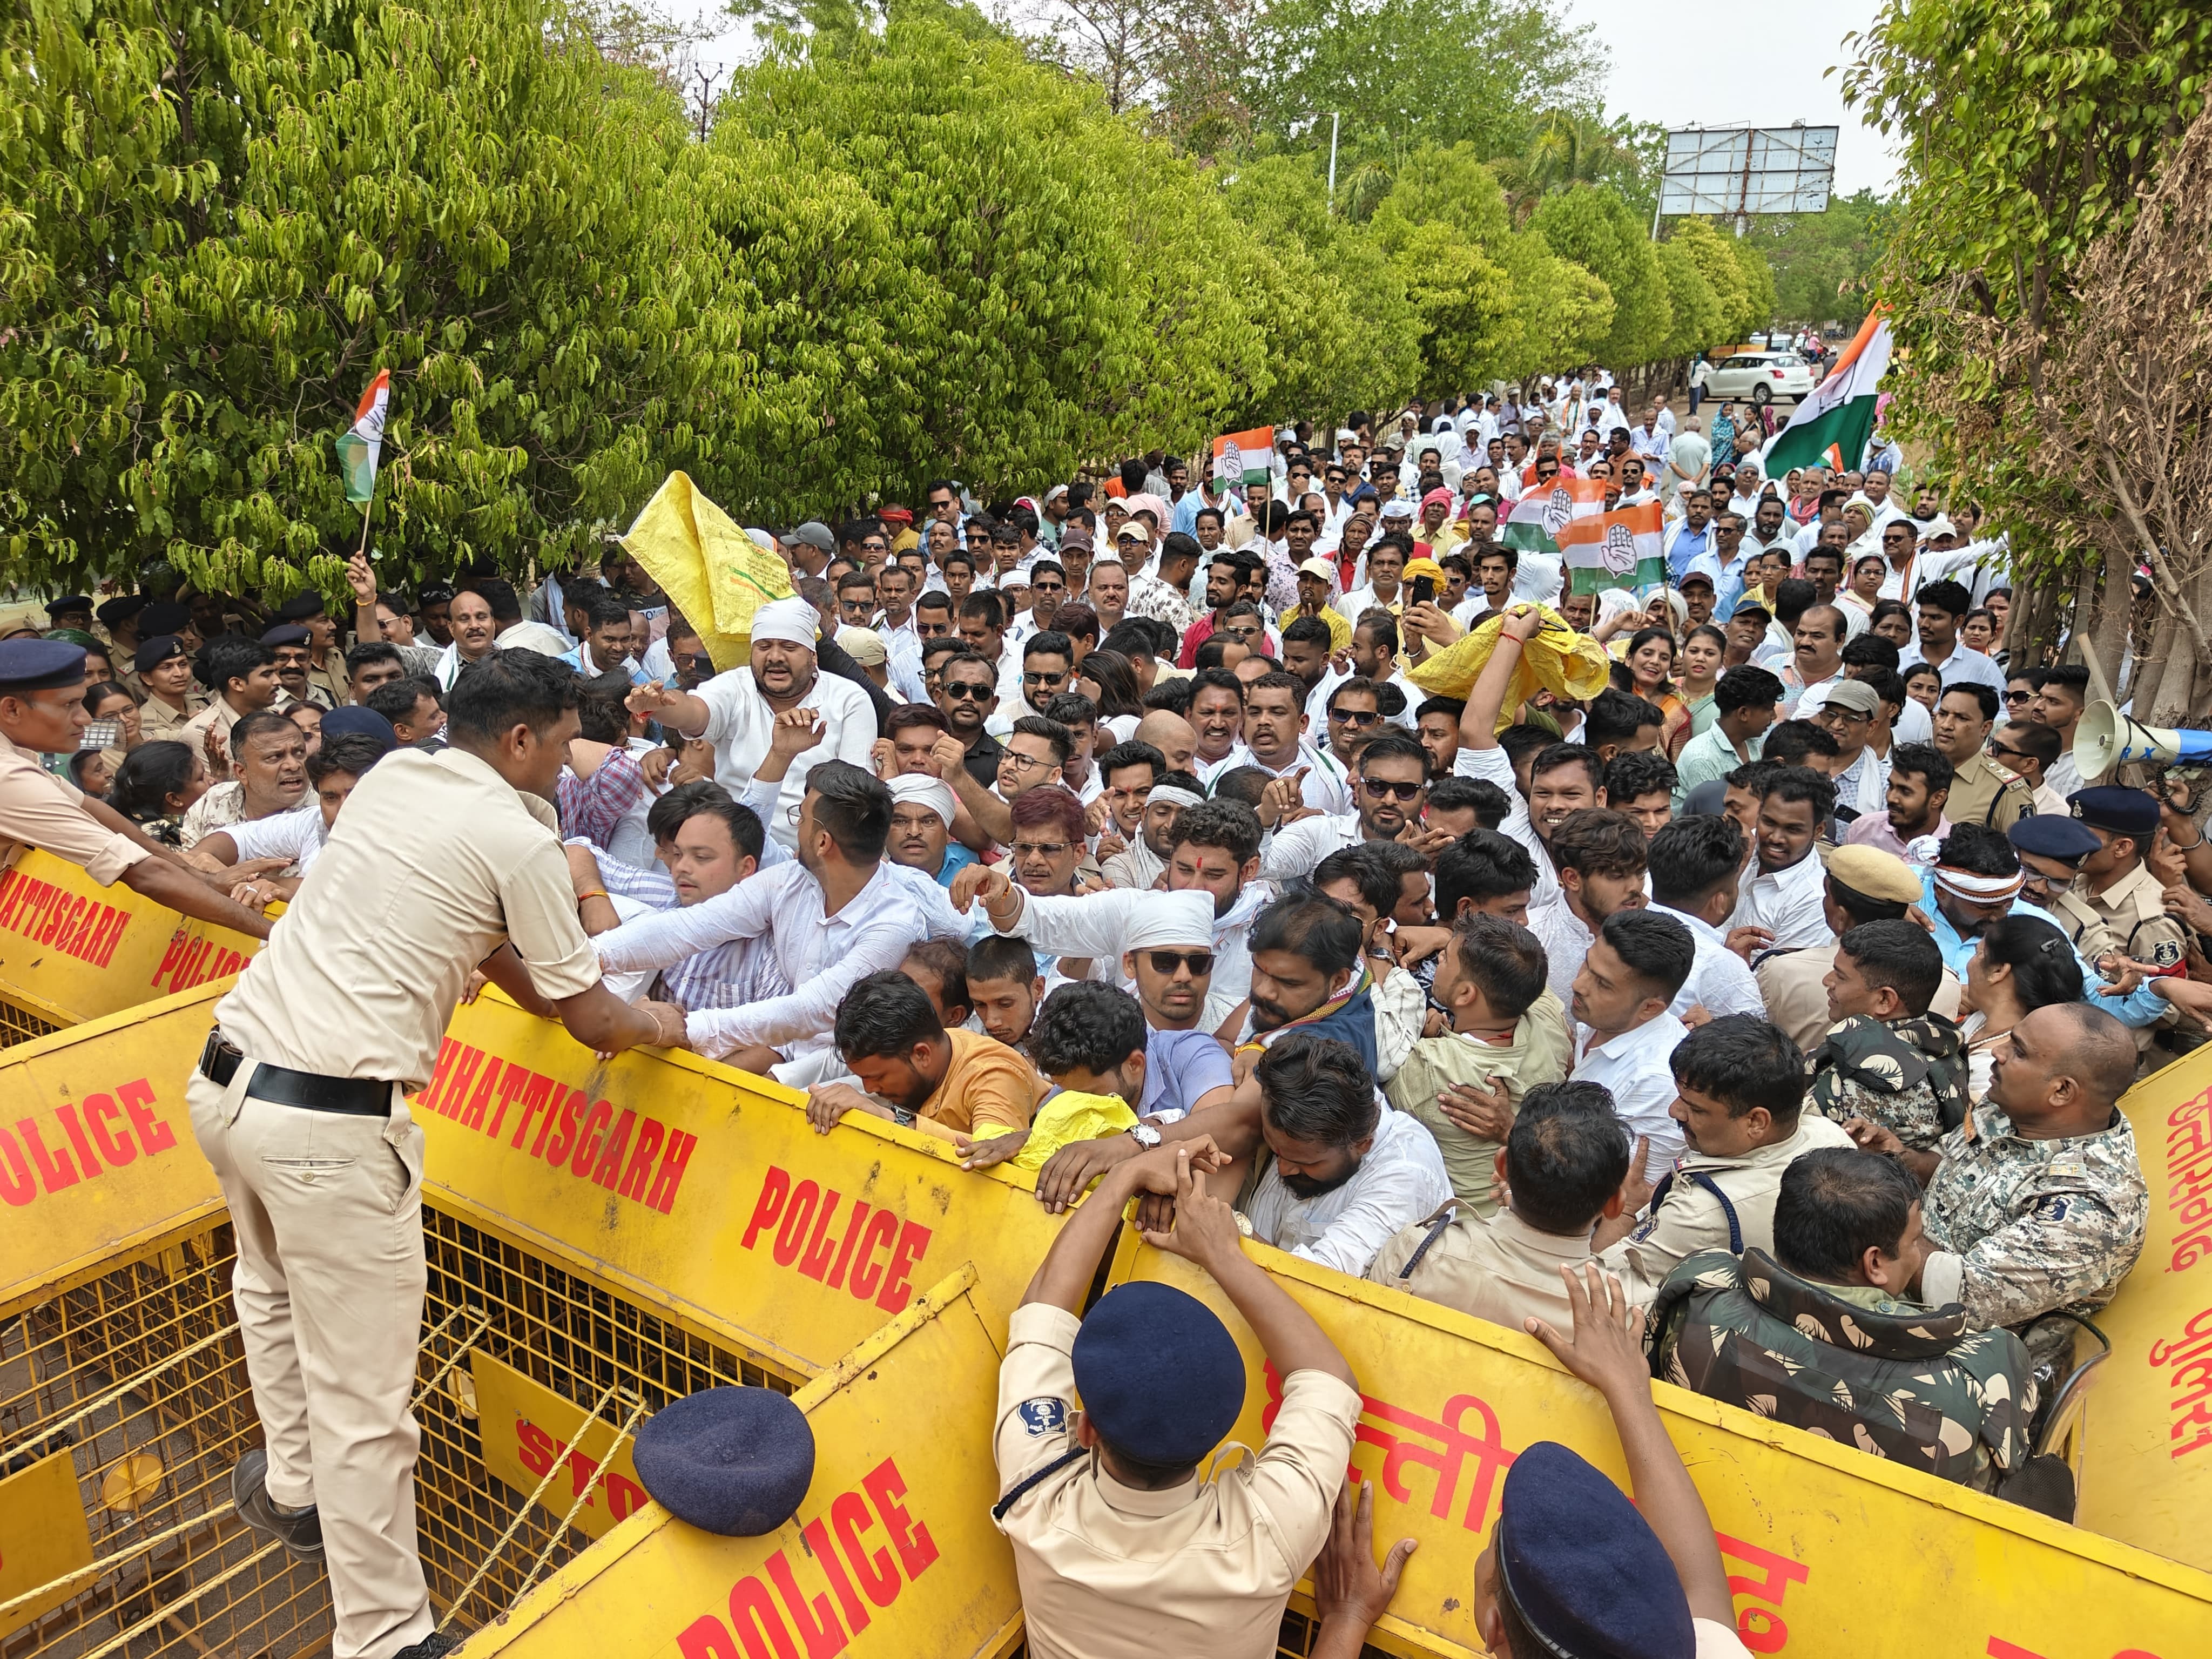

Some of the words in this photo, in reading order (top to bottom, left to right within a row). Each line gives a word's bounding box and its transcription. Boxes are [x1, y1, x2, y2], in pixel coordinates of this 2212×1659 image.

[404, 1035, 698, 1215] HHATTISGARH
[741, 1165, 932, 1314] POLICE
[516, 1419, 653, 1523] STO
